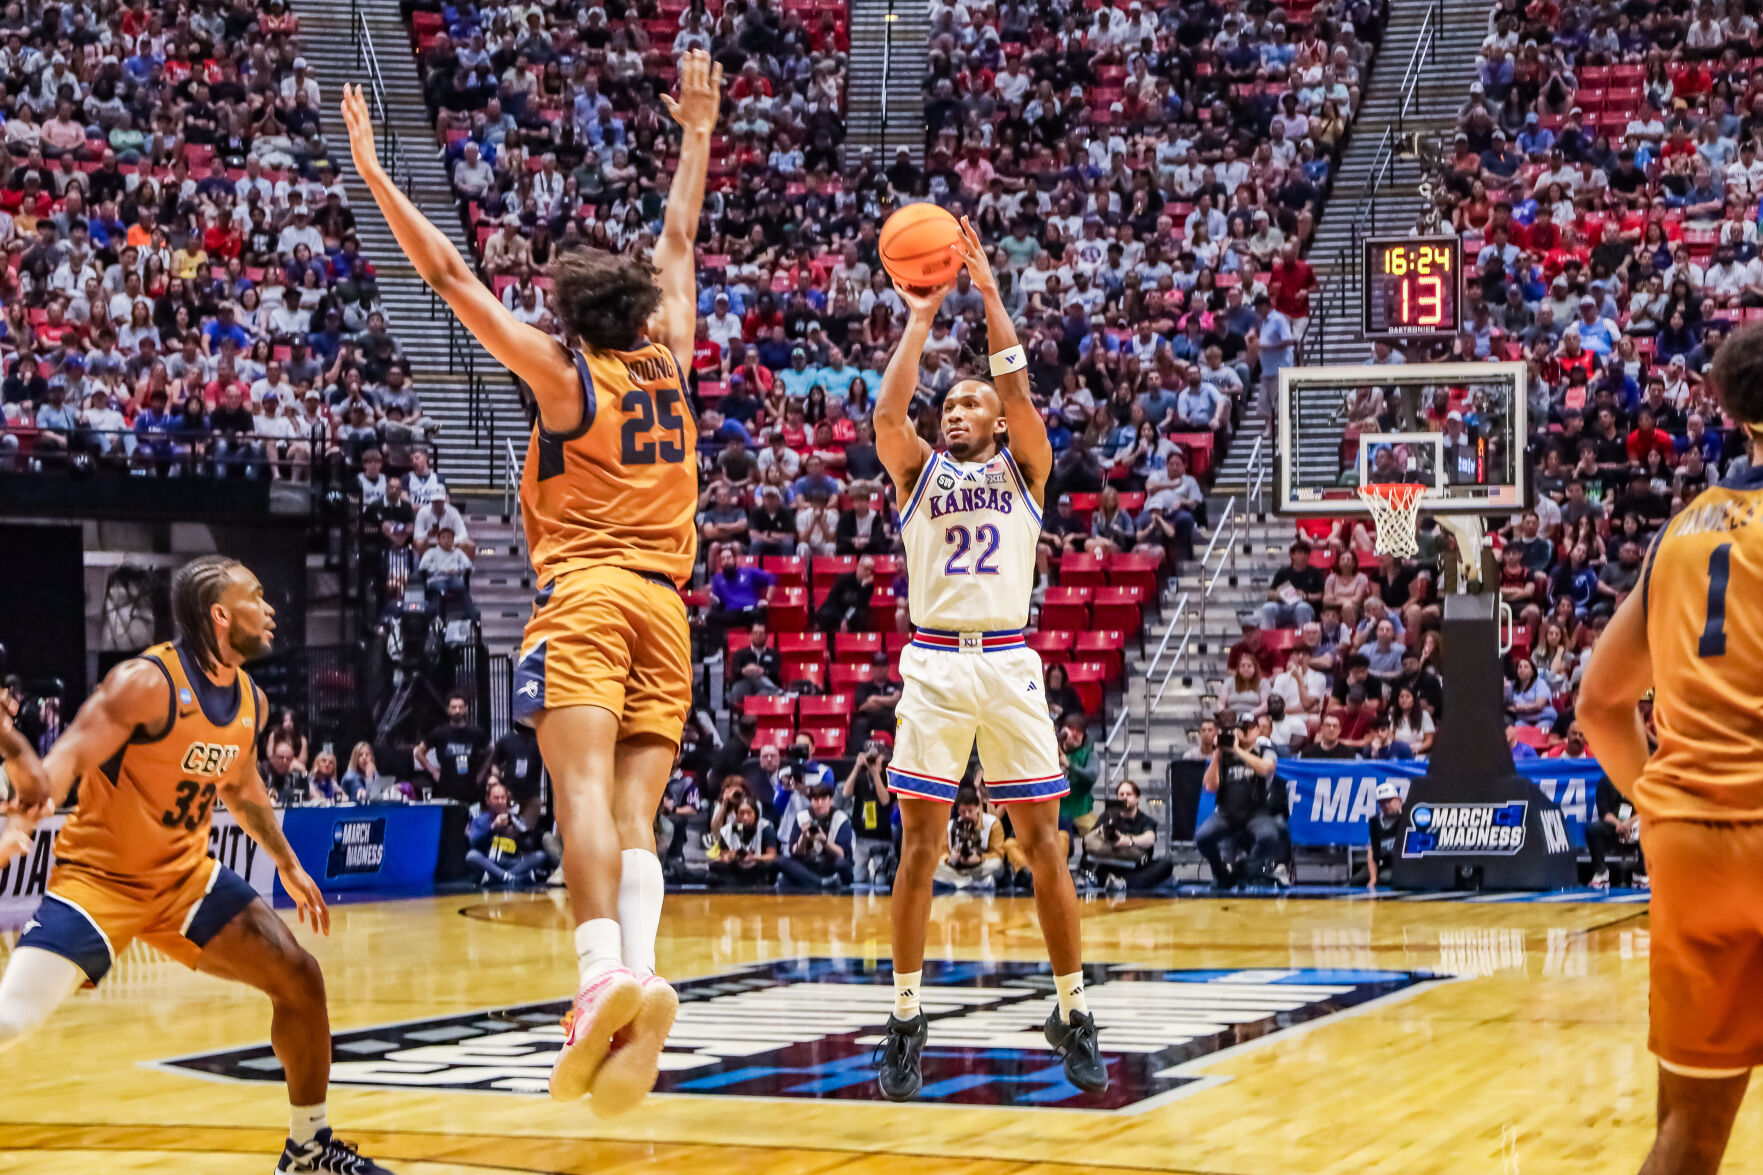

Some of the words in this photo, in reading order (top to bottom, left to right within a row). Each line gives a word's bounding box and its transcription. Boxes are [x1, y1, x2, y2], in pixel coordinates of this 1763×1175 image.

[1384, 246, 1450, 276] 16:24
[1402, 275, 1442, 325] 13
[620, 388, 686, 465] 25
[937, 475, 956, 490] SW
[928, 486, 1014, 520] KANSAS
[944, 522, 1001, 577] 22
[1698, 542, 1733, 658] 1
[963, 637, 978, 648] KU
[161, 779, 218, 833] 33
[1431, 807, 1494, 829] MARCH
[341, 823, 371, 846] MARCH
[1437, 825, 1524, 849] MADNESS
[345, 844, 384, 868] MADNESS
